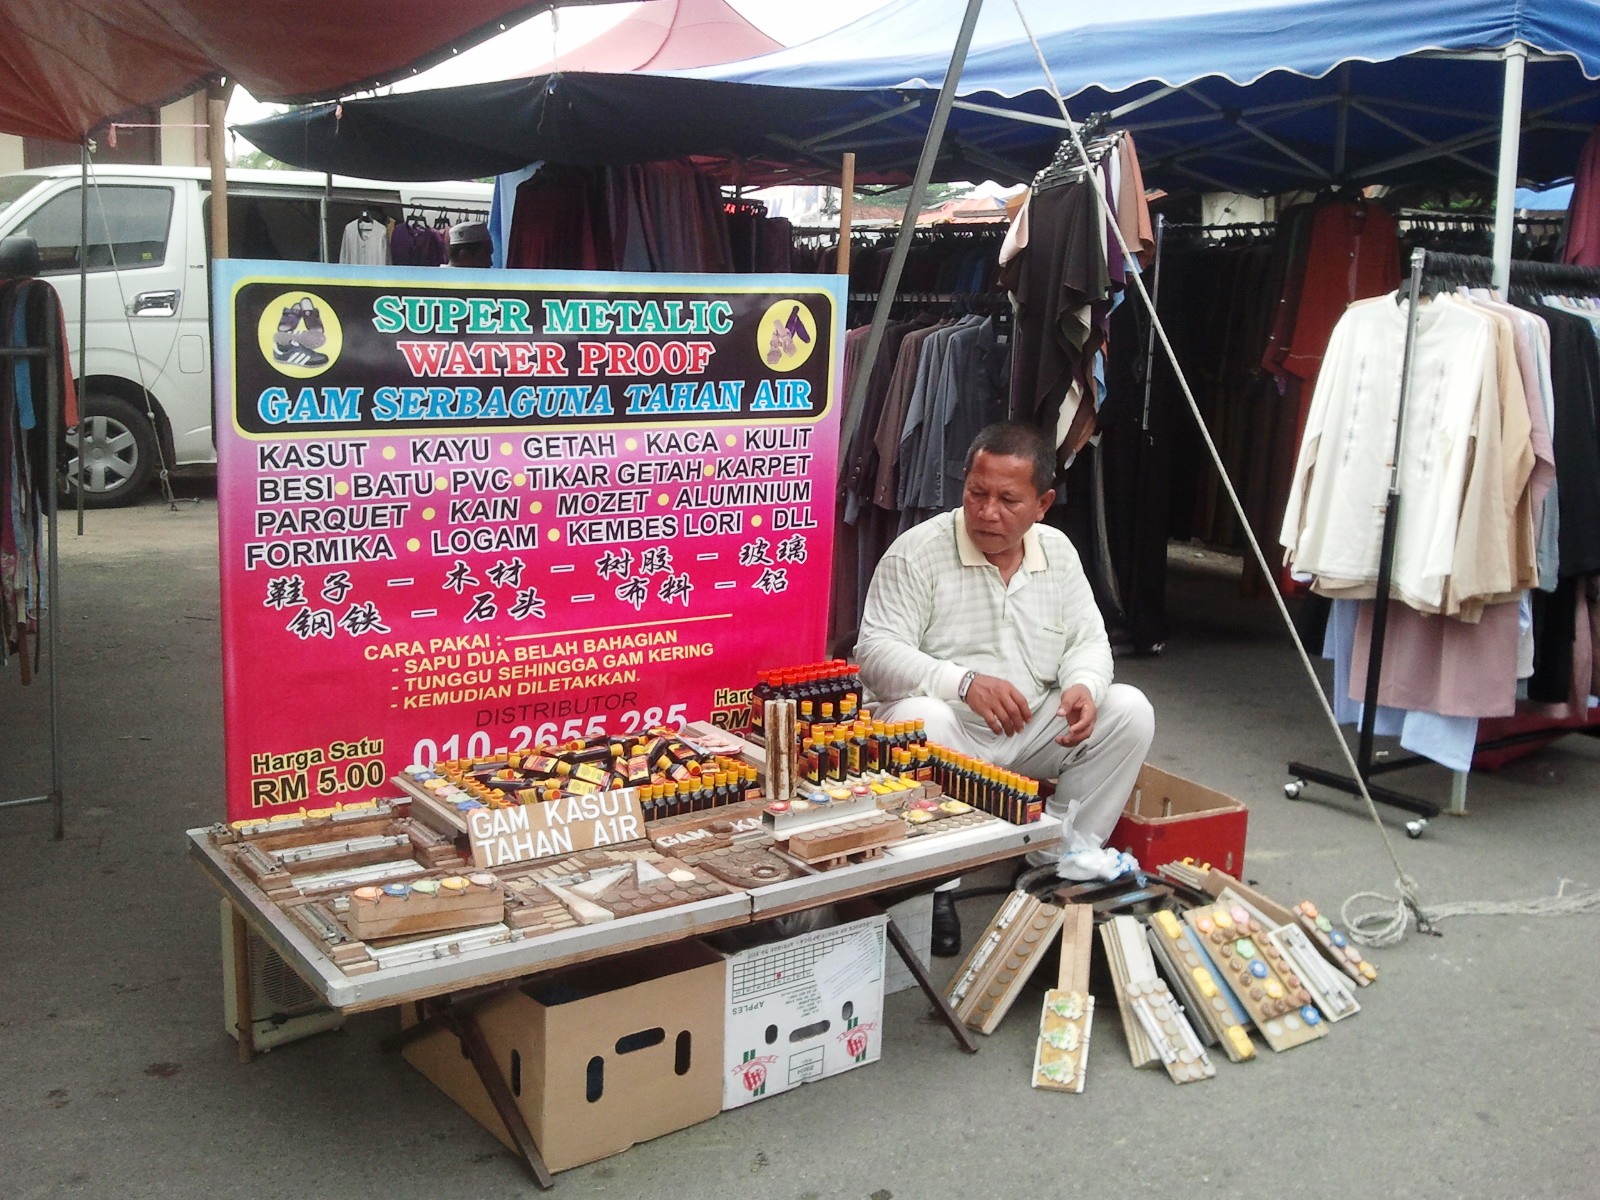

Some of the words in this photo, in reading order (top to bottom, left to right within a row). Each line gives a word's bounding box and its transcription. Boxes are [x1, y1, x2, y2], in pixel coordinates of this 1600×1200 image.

[372, 295, 533, 334] SUPER
[542, 298, 733, 334] METALIC
[397, 341, 568, 377] WATER
[578, 341, 716, 376] PROOF
[258, 386, 364, 424] GAM
[371, 384, 614, 421] SERBAGUNA
[624, 380, 745, 415] TAHAN
[750, 379, 813, 411] AIR
[258, 441, 367, 471] KASUT
[410, 437, 491, 466] KAYU
[522, 432, 617, 460] GETAH
[644, 429, 719, 456] KACA
[744, 427, 813, 451] KULIT
[257, 475, 335, 504] BESI
[352, 470, 436, 500] BATU
[451, 468, 513, 495] PVC
[525, 463, 610, 490] TIKAR
[617, 457, 703, 485] GETAH
[716, 454, 812, 480] KARPET
[255, 502, 411, 537] PARQUET
[449, 496, 521, 525] KAIN
[556, 489, 651, 518] MOZET
[672, 480, 812, 510] ALUMINIUM
[244, 533, 397, 570] FORMIKA
[430, 523, 539, 557] LOGAM
[566, 515, 678, 547] KEMBES
[683, 511, 743, 537] LORI
[771, 506, 818, 531] DLL
[263, 571, 353, 610] 鞋子
[442, 557, 527, 594] 木材
[595, 546, 674, 580] 树胶
[738, 534, 808, 566] 玻璃
[286, 602, 391, 640] 钢铁
[463, 586, 546, 622] 石头
[615, 573, 695, 611] 布料
[751, 566, 790, 594] 铝
[363, 640, 425, 661] CARA
[403, 653, 462, 675] SAPU
[466, 649, 510, 668] DUA
[514, 641, 578, 664] BELAH
[582, 629, 678, 655] BAHAGIAN
[403, 669, 492, 694] TUNGGU
[497, 656, 600, 682] SEHINGGA
[602, 650, 644, 669] GAM
[648, 642, 715, 663] KERING
[402, 686, 511, 710] KEMUDIAN
[517, 669, 641, 697] DILETAKKAN.
[475, 690, 638, 728] DISTRIBUTOR
[713, 687, 753, 708] Harg
[710, 706, 753, 731] RM
[252, 748, 325, 775] Harga
[329, 736, 384, 761] Satu
[251, 771, 310, 808] RM
[317, 759, 386, 797] 5.00
[469, 805, 531, 839] GAM
[543, 787, 634, 827] KASUT
[476, 826, 573, 866] TAHAN
[655, 827, 714, 848] GAM
[732, 1000, 765, 1016] APPLES
